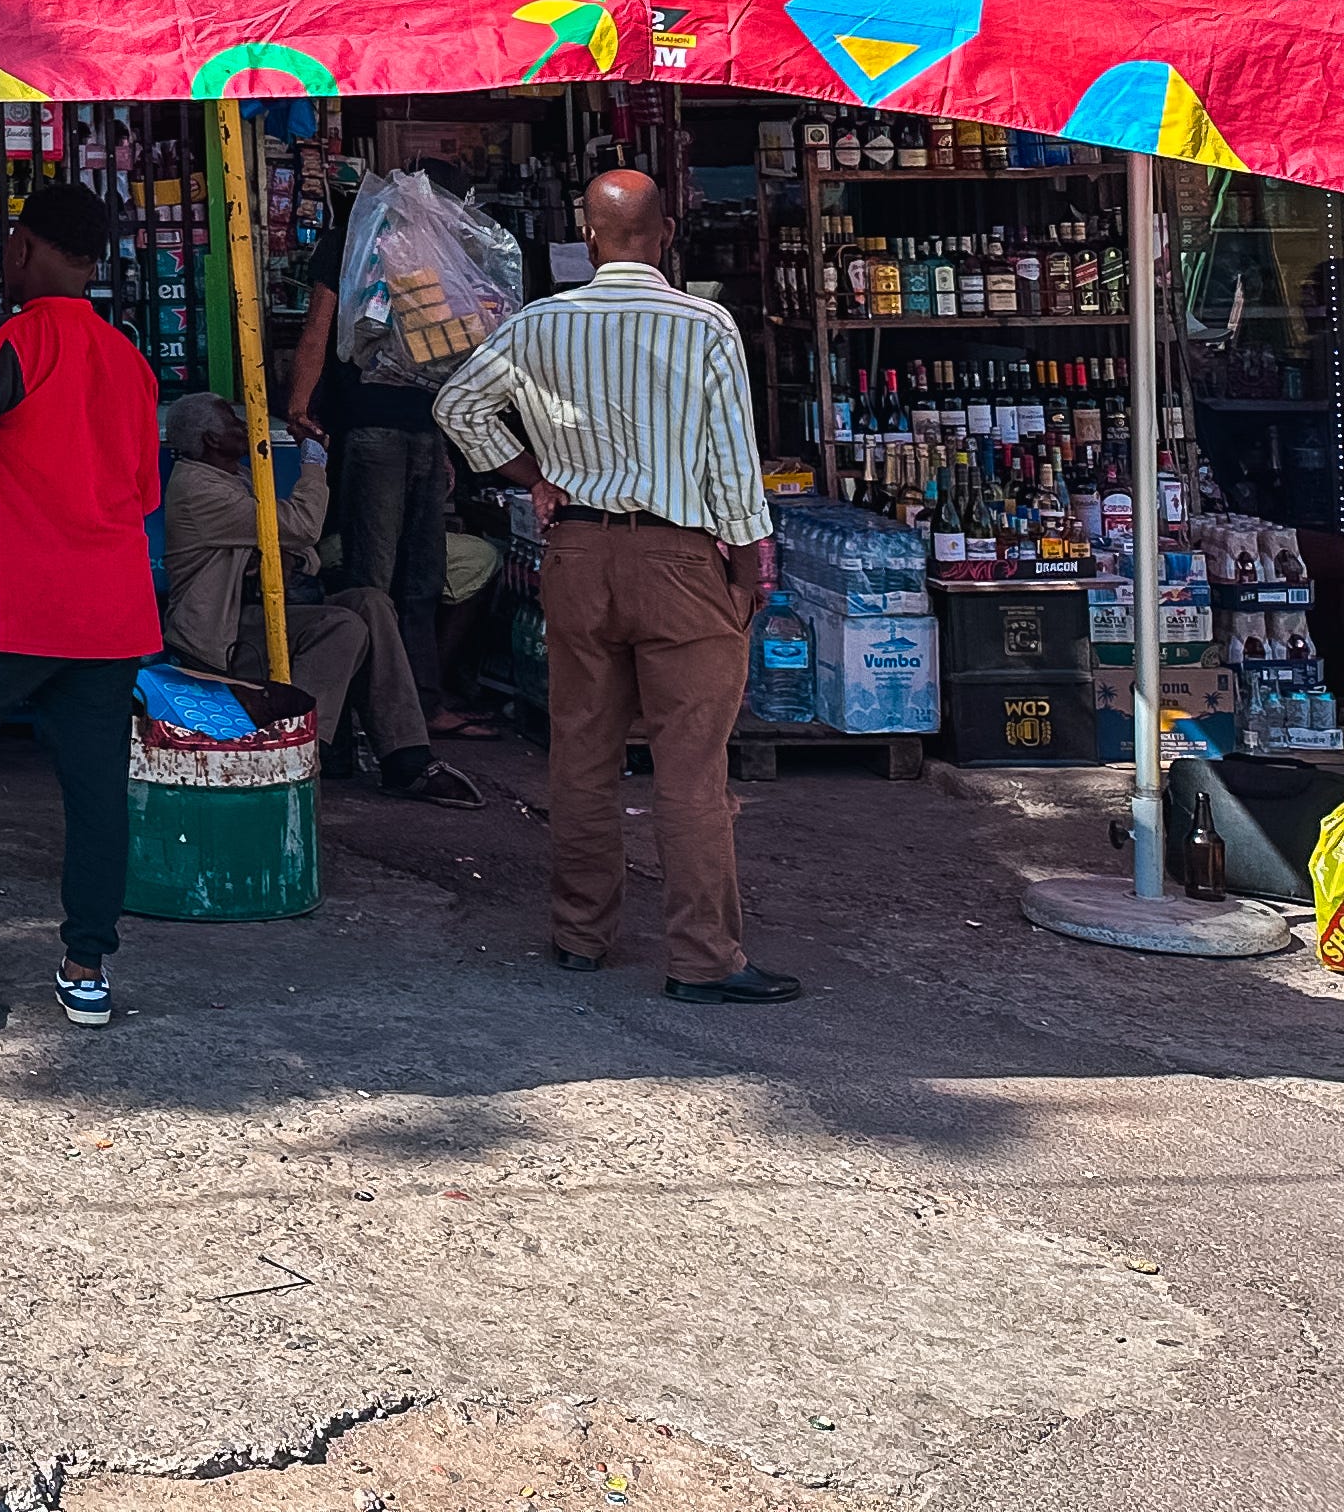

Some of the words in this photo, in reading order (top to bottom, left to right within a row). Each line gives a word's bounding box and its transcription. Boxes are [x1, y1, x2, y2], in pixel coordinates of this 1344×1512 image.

[653, 47, 688, 68] M
[1035, 560, 1078, 575] DRAGON
[1094, 615, 1126, 625] CASTLE
[1166, 615, 1199, 625] CASTLE
[863, 654, 921, 668] Vumba
[1004, 701, 1051, 717] CDM
